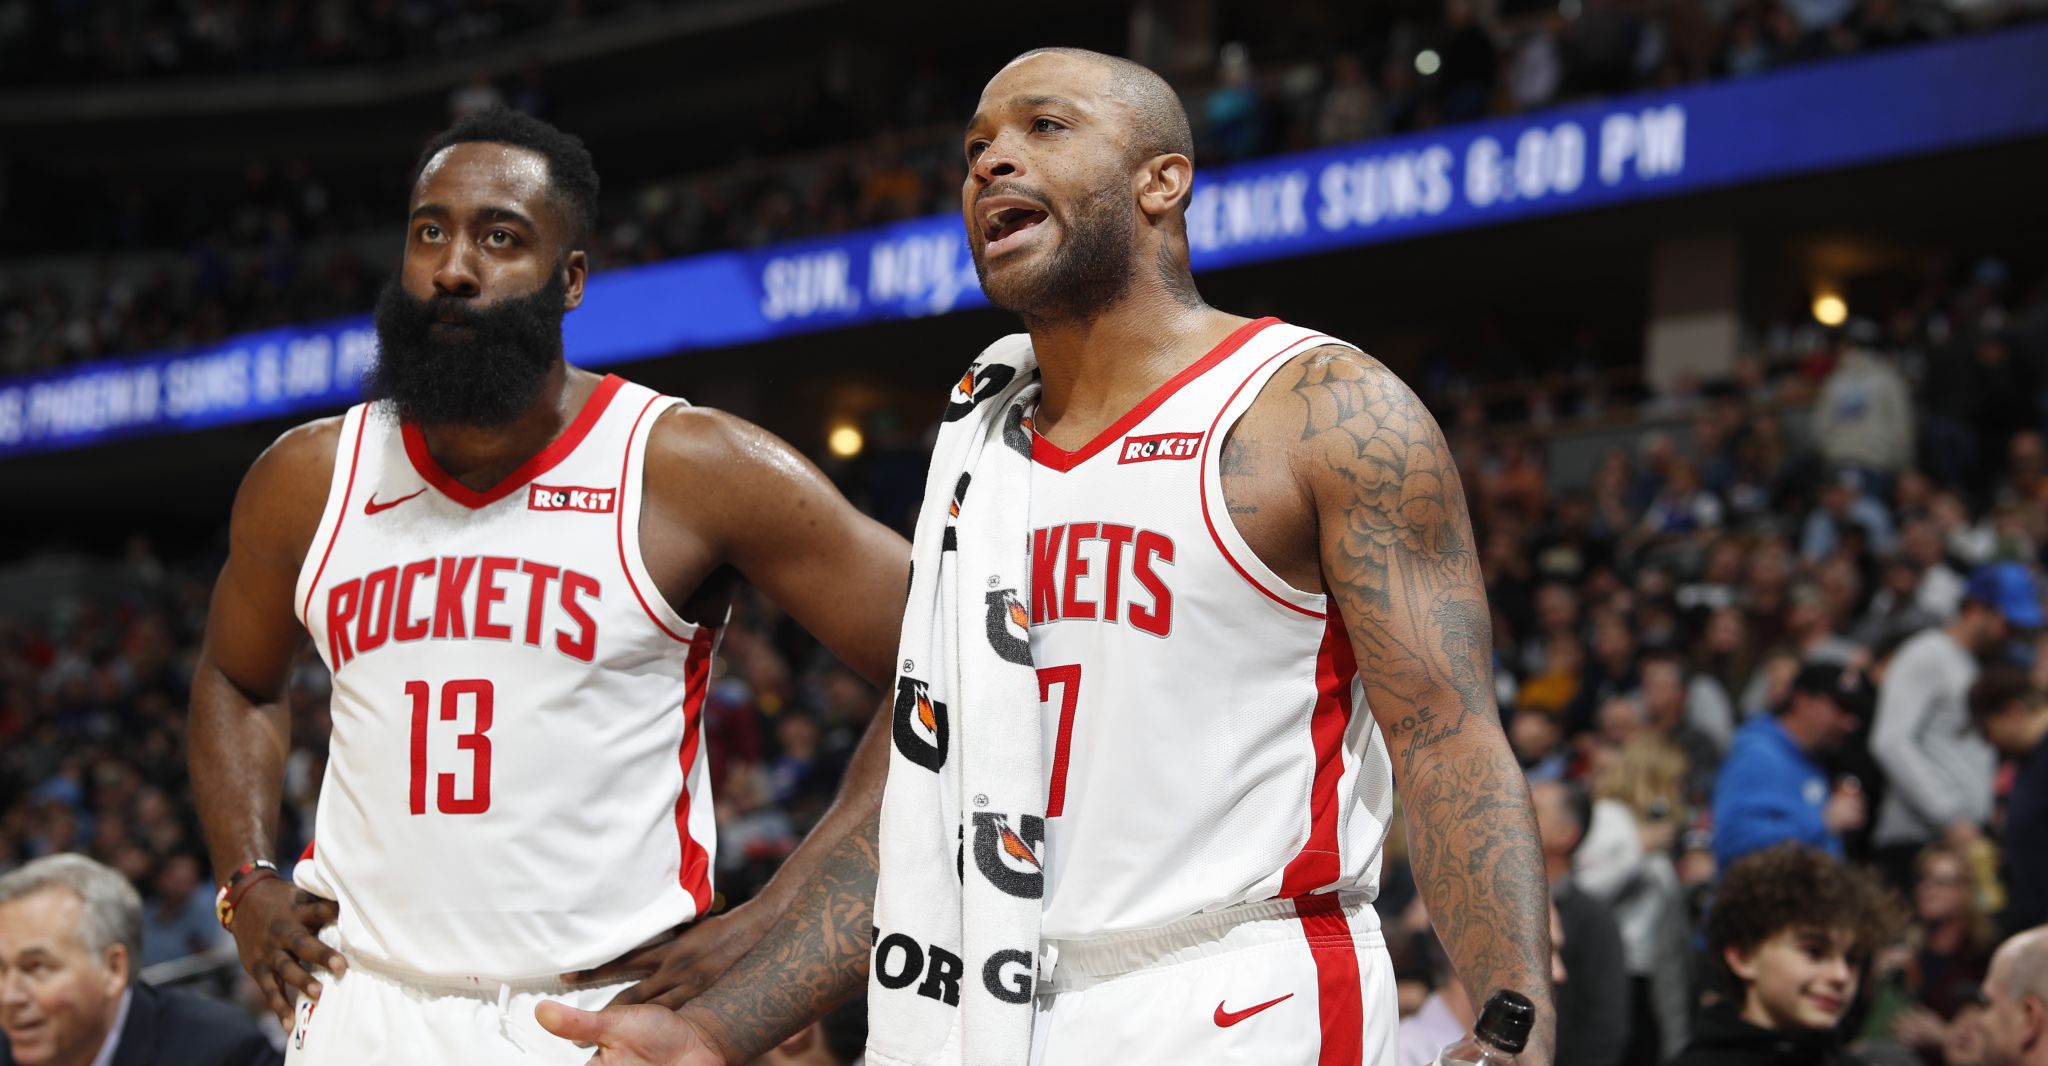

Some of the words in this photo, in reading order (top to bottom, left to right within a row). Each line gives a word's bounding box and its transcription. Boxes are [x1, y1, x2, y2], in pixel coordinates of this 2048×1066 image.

[1318, 144, 1454, 231] SUNS
[1464, 121, 1586, 208] 6:00
[1599, 104, 1686, 185] PM
[166, 349, 252, 418] SUNS
[327, 554, 602, 673] ROCKETS
[1028, 521, 1176, 639] KETS
[404, 679, 494, 815] 13
